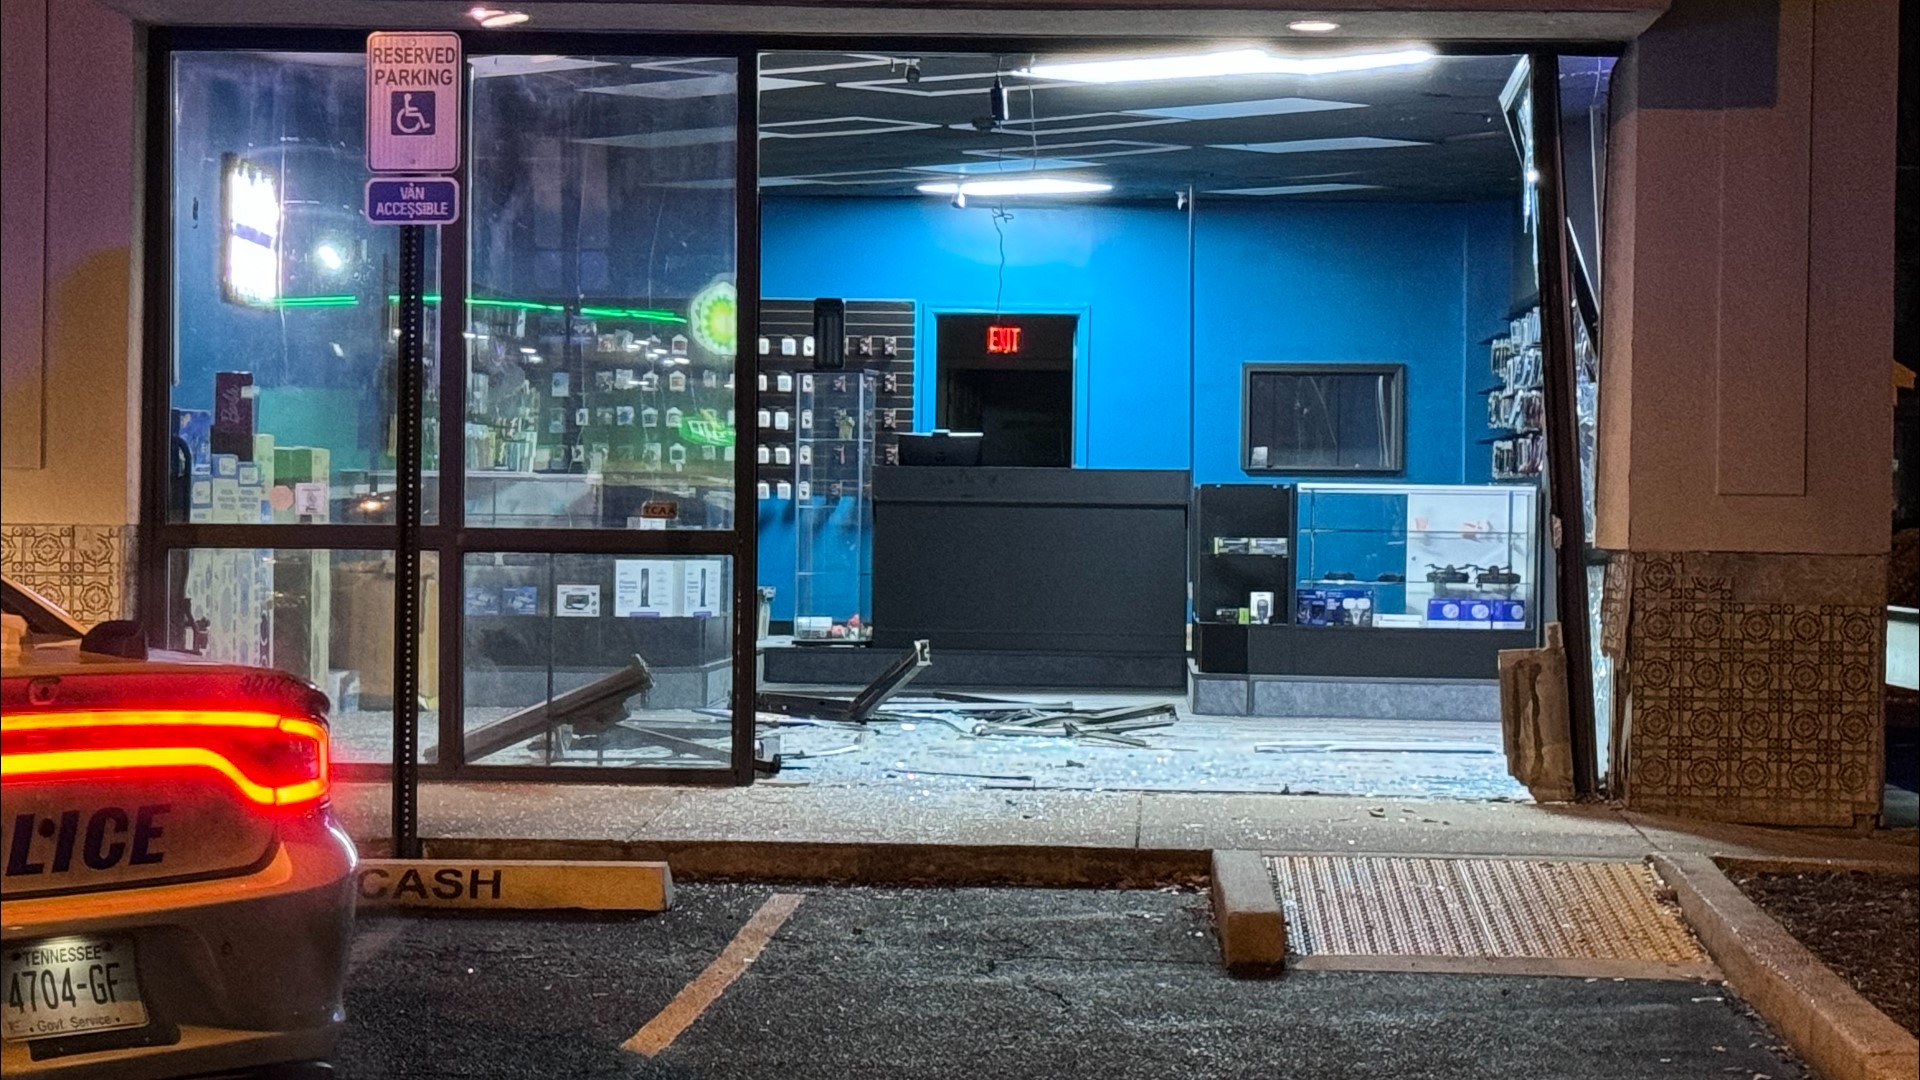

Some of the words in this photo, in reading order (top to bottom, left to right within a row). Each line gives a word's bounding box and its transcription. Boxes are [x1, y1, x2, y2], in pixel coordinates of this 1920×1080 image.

[372, 47, 455, 64] RESERVED
[374, 69, 453, 86] PARKING
[399, 187, 425, 200] VAN
[376, 202, 449, 216] ACCESSIBLE
[989, 327, 1022, 353] EXIT
[5, 804, 171, 877] LICE
[357, 868, 501, 900] CASH
[22, 945, 102, 966] TENNESSEE
[9, 962, 120, 1014] 4704-GF
[37, 1016, 64, 1032] Govt
[70, 1015, 112, 1029] Service
